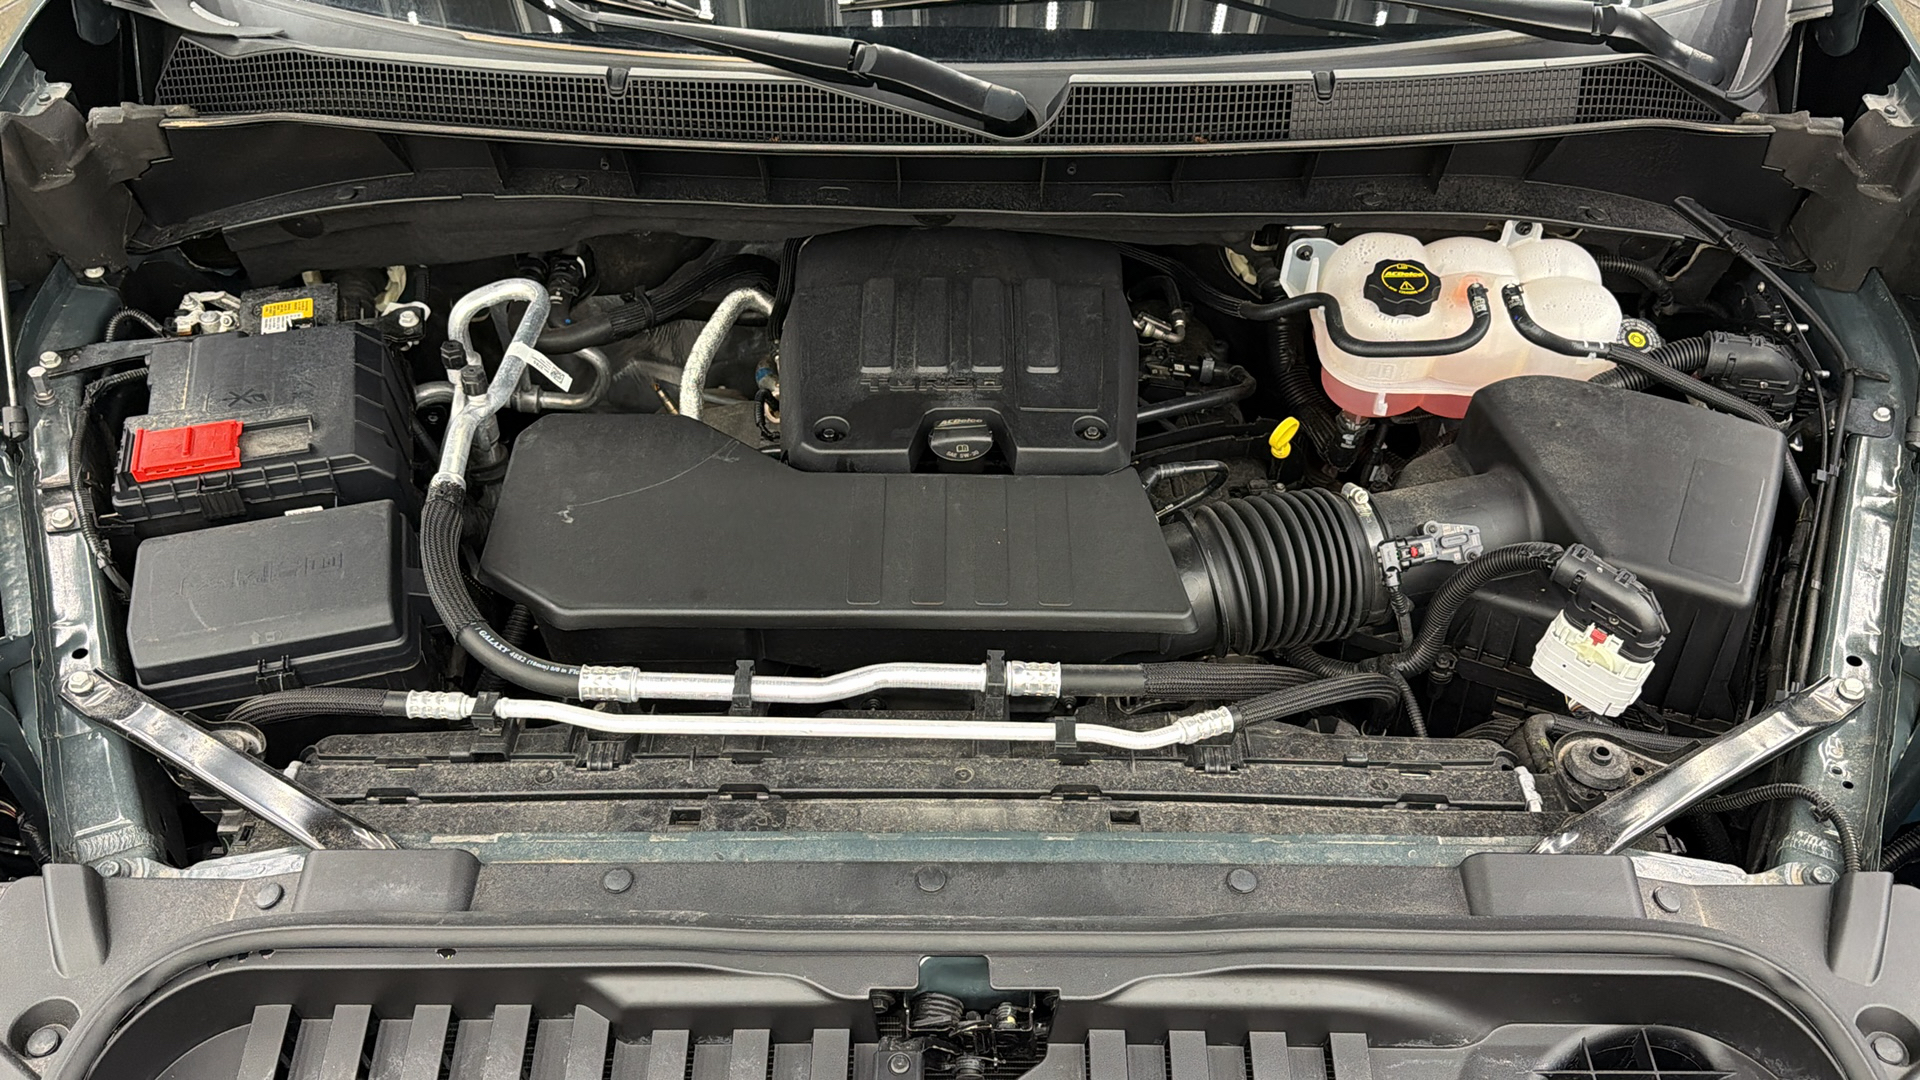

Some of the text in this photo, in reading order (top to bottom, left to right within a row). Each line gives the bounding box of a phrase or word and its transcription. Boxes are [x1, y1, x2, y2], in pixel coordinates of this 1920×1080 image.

[859, 378, 1003, 392] TURBO
[937, 418, 983, 427] ACDelco
[479, 629, 510, 653] GALAXY
